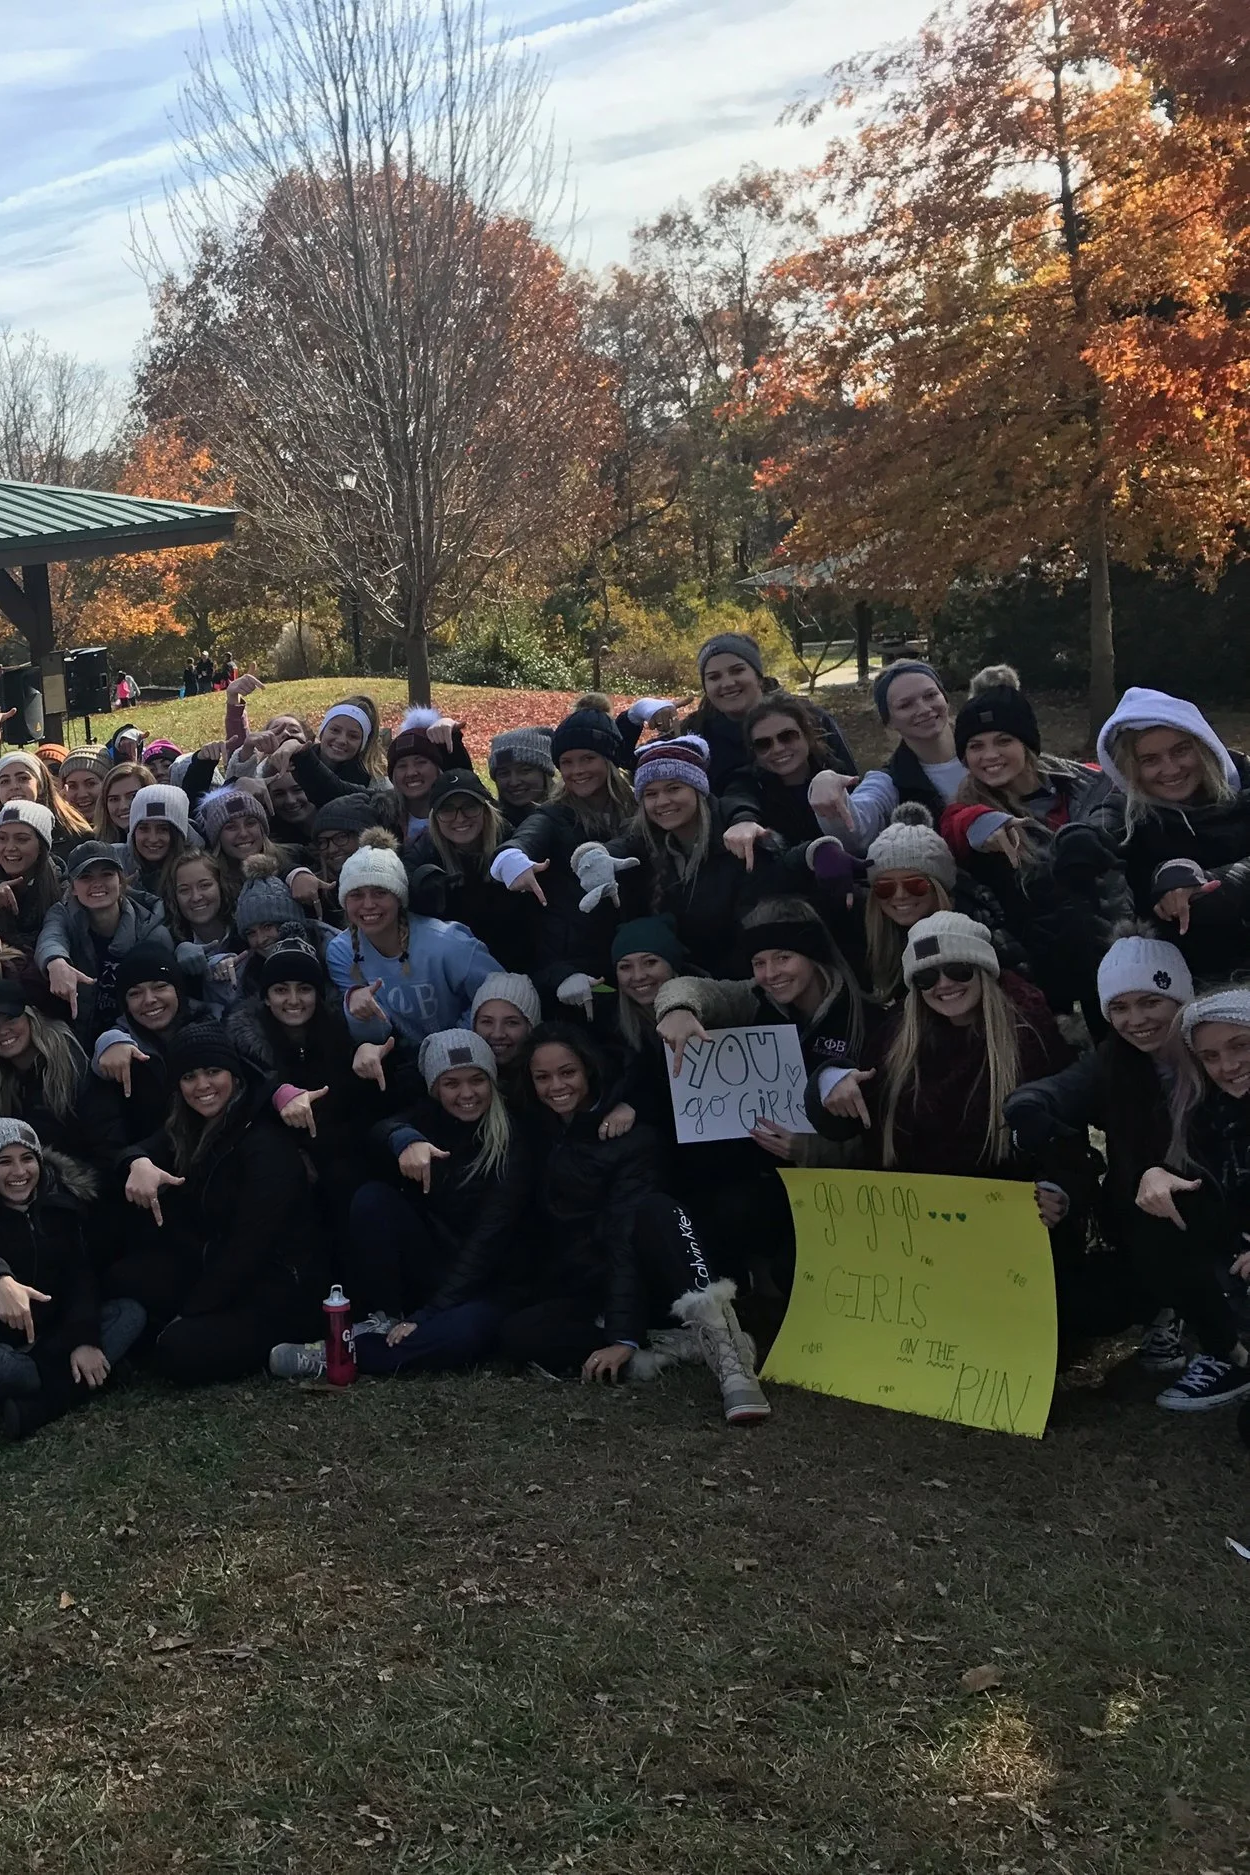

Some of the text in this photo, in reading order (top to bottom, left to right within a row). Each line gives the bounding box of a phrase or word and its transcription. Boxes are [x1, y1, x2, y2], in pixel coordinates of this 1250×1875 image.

[682, 1032, 780, 1089] YOU
[679, 1092, 731, 1135] go
[814, 1182, 844, 1247] go
[857, 1184, 885, 1252] go
[686, 1241, 711, 1291] Calvin
[824, 1265, 930, 1329] GIRLS
[900, 1338, 960, 1362] ON THE
[949, 1363, 1032, 1432] RUN
